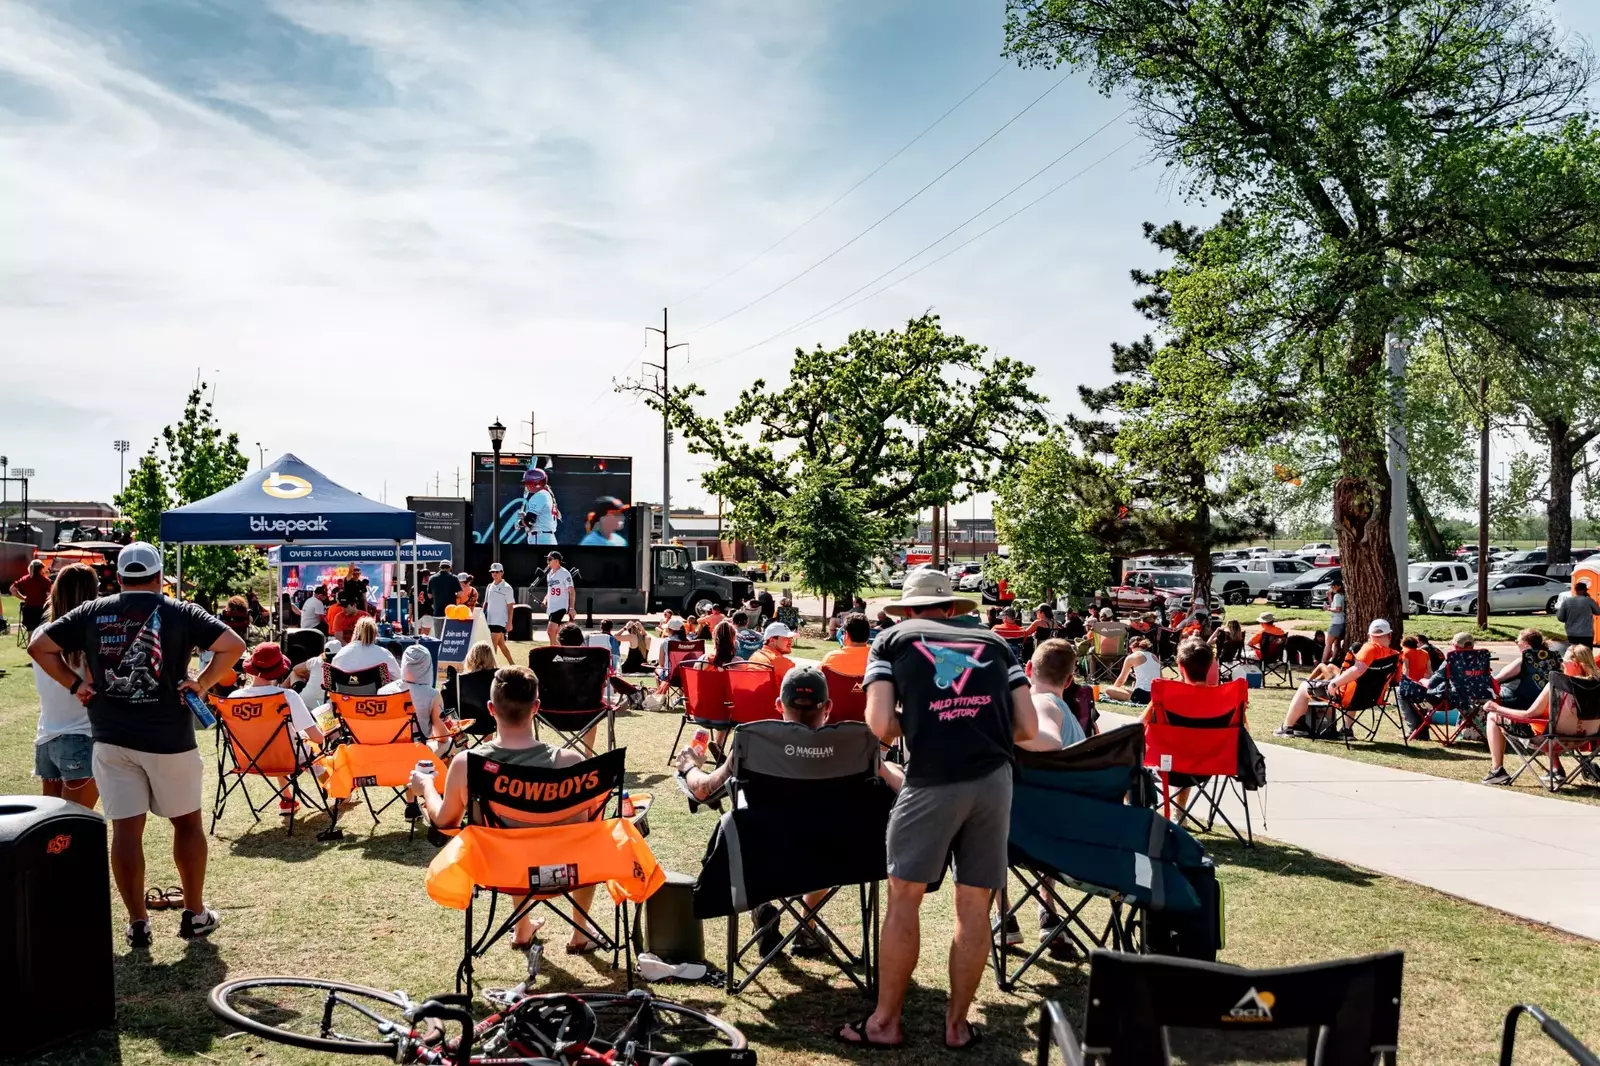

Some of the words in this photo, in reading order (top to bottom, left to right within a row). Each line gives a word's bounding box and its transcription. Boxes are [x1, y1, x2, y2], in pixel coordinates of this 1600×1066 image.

[250, 516, 328, 535] bluepeak
[551, 588, 561, 596] 99
[101, 635, 127, 644] EDUCATE
[442, 647, 458, 655] today!
[953, 695, 992, 706] FITNESS
[232, 702, 263, 721] OSU
[355, 700, 387, 717] OSU
[939, 708, 980, 721] FACTORY
[796, 746, 834, 755] MAGELLAN
[493, 770, 599, 801] COWBOYS
